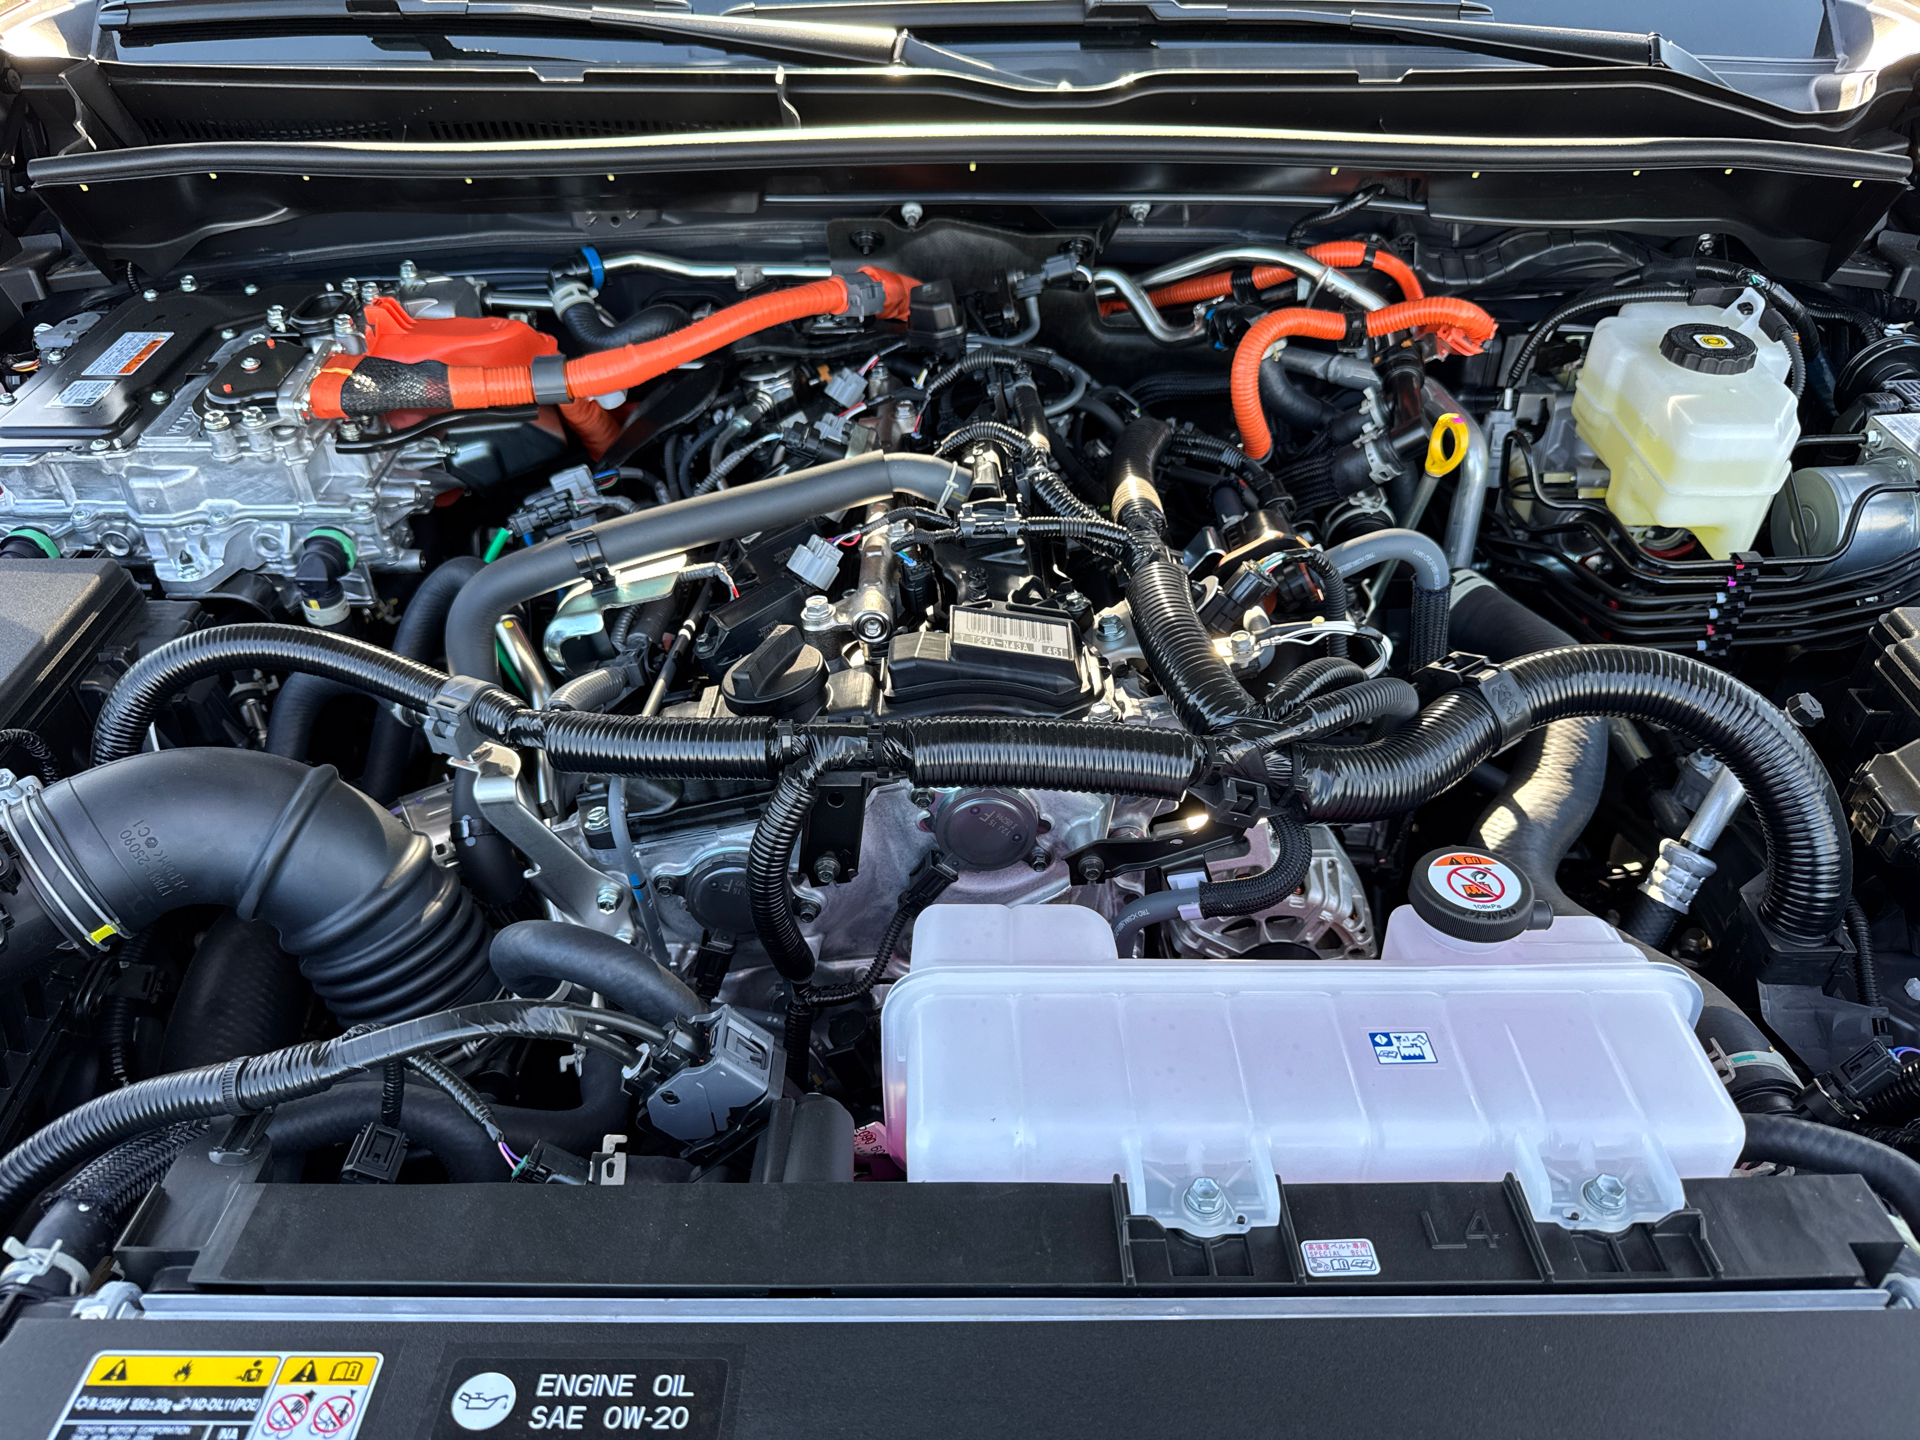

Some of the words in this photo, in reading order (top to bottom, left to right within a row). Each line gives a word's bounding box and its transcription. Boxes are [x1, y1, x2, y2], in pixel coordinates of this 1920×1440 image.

[970, 635, 1029, 652] T24A-N43A
[1046, 647, 1064, 657] 461
[979, 810, 996, 823] F
[119, 829, 173, 897] 17881-25090
[1463, 907, 1518, 921] DENSO
[1420, 1209, 1499, 1250] L4
[536, 1374, 637, 1397] ENGINE
[652, 1374, 695, 1397] OIL
[190, 1397, 262, 1412] ND-OIL11(POE)
[528, 1405, 587, 1430] SAE
[603, 1405, 690, 1430] 0W-20
[218, 1427, 240, 1440] NA
